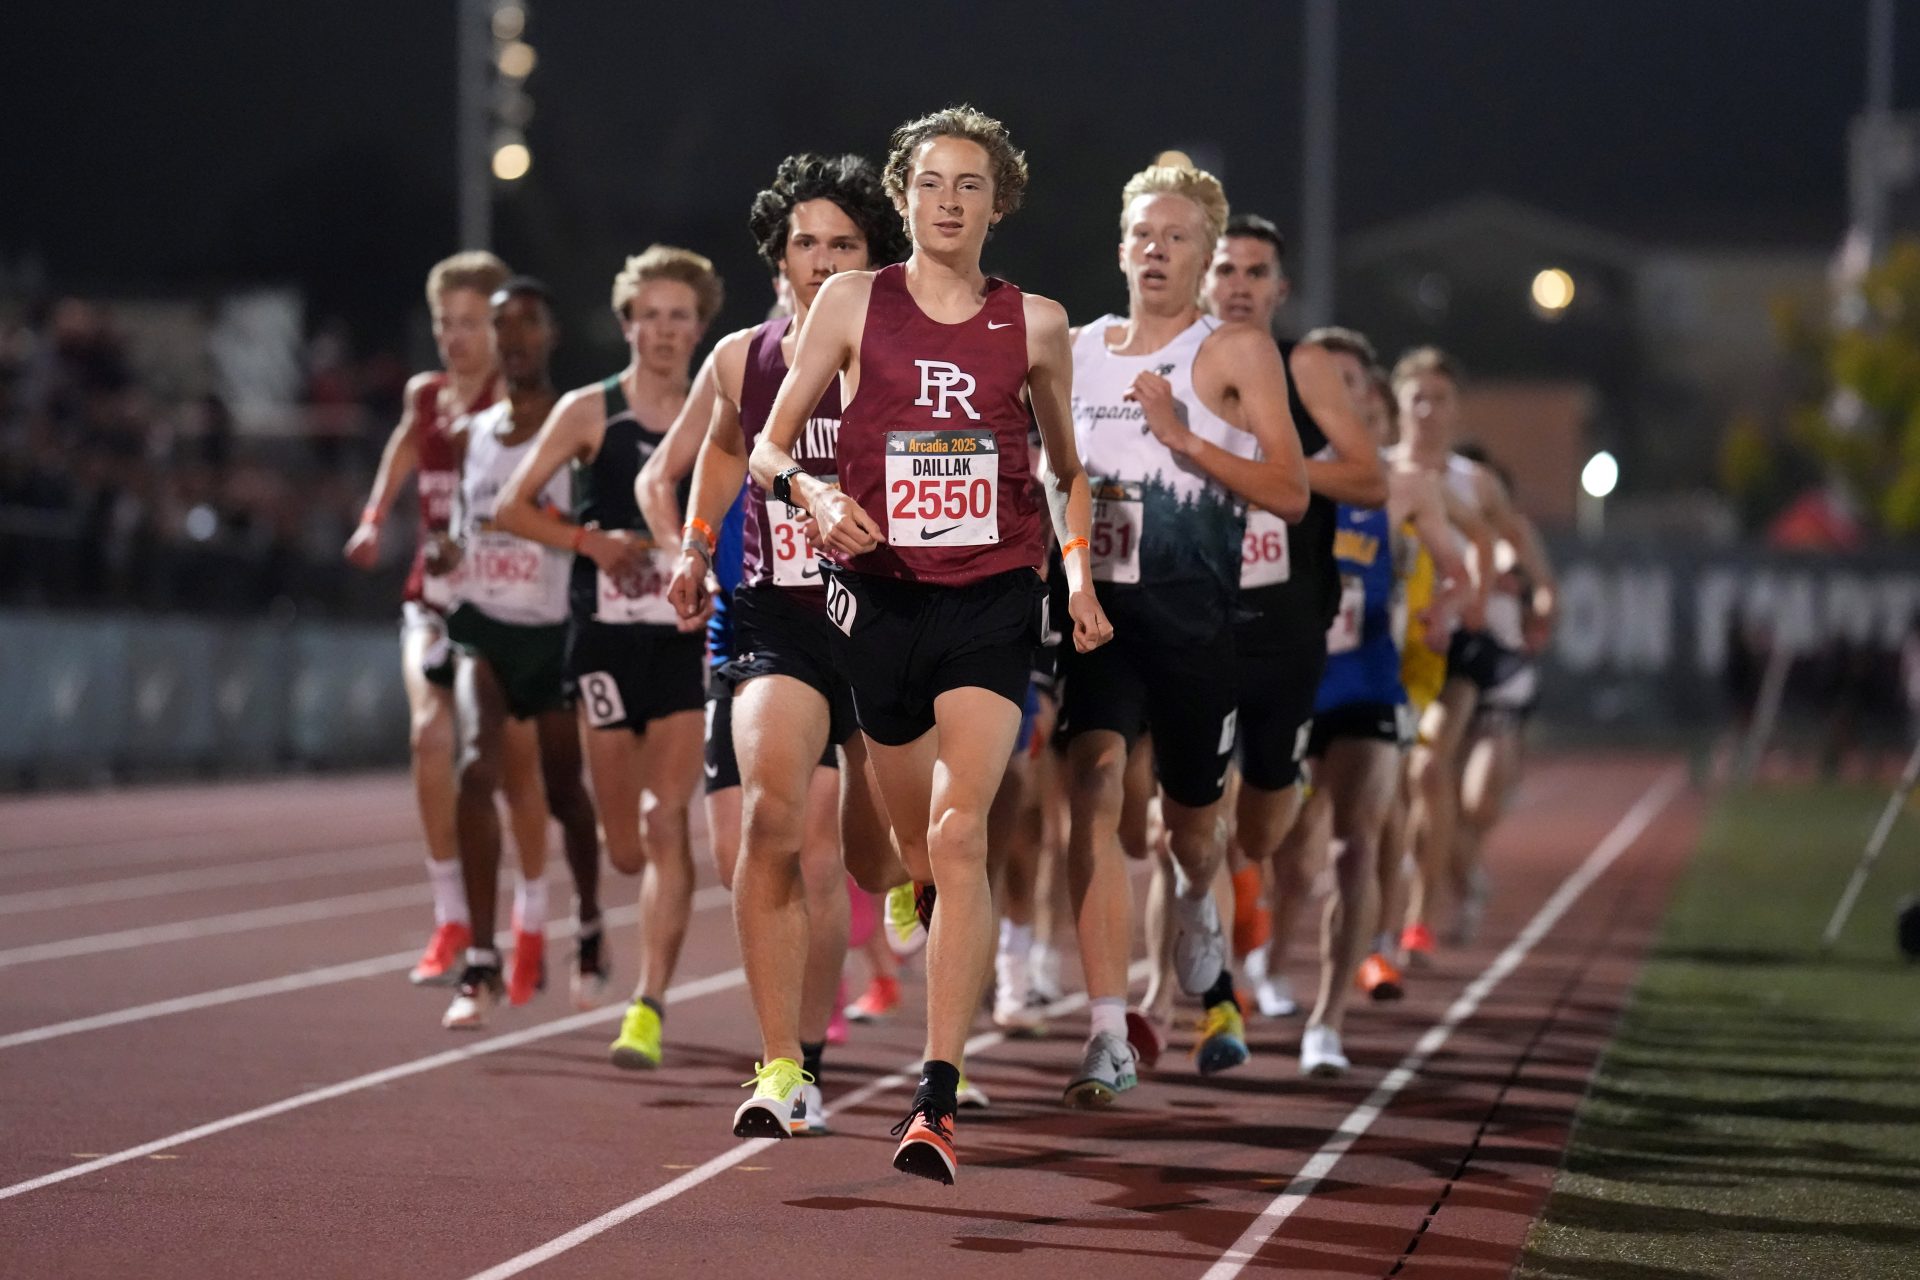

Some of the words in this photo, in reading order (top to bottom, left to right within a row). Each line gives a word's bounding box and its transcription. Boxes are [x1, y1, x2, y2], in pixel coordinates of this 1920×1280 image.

[909, 438, 948, 453] Arcadia
[951, 438, 977, 452] 2025
[913, 458, 971, 476] DAILLAK
[892, 478, 992, 520] 2550
[588, 678, 614, 719] 8
